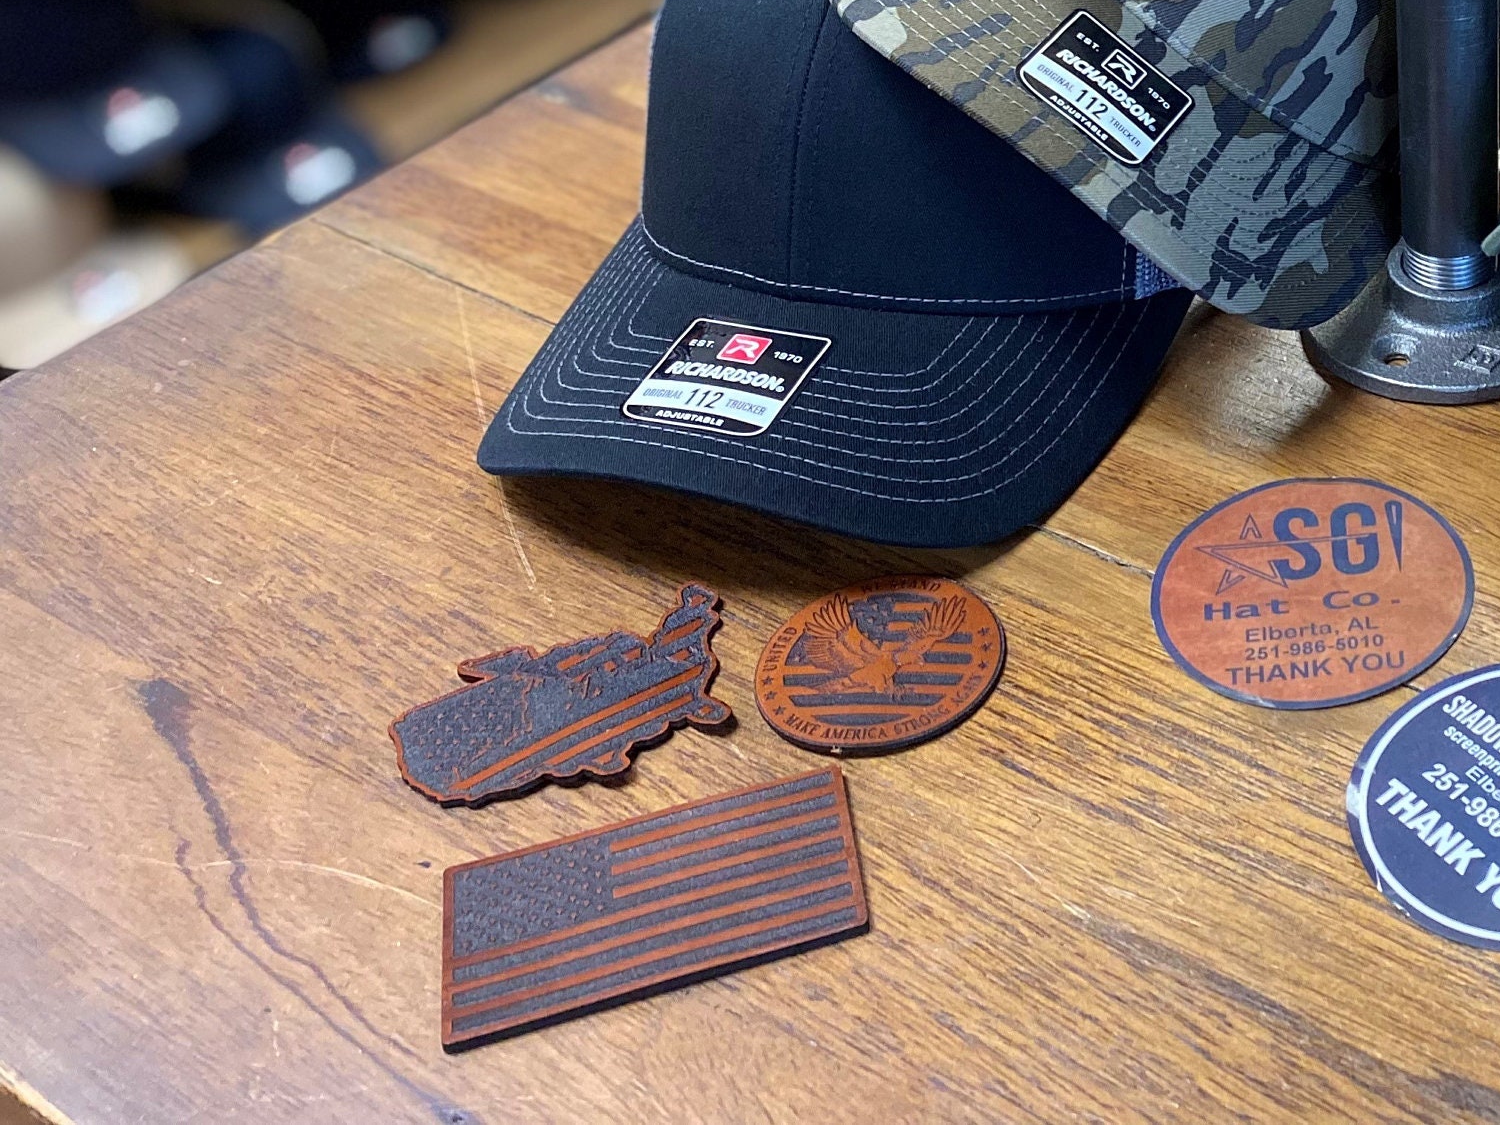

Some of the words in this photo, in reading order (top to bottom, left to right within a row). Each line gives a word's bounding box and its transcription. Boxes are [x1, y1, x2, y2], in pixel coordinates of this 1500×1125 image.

[1075, 32, 1100, 52] EST.
[1037, 64, 1075, 93] ORIGINAL
[1075, 88, 1109, 120] 112
[1109, 116, 1142, 148] TRUCKER
[1049, 94, 1109, 142] ADJUSTABLE
[688, 338, 714, 348] EST.
[773, 351, 803, 364] 1970
[642, 388, 683, 400] ORIGINAL
[684, 388, 724, 409] 112
[725, 398, 767, 416] TRUCKER
[655, 409, 725, 427] ADJUSTABLE
[1203, 599, 1290, 621] Hat
[1245, 622, 1340, 643] Elberta,
[1347, 616, 1379, 632] AL
[762, 625, 799, 673] UNITED
[1245, 633, 1384, 661] 251-986-5010
[1225, 655, 1332, 686] THANK
[1342, 650, 1406, 674] YOU
[782, 712, 822, 737] MAKE
[820, 725, 888, 741] AMERICA
[1375, 777, 1486, 876] THANK
